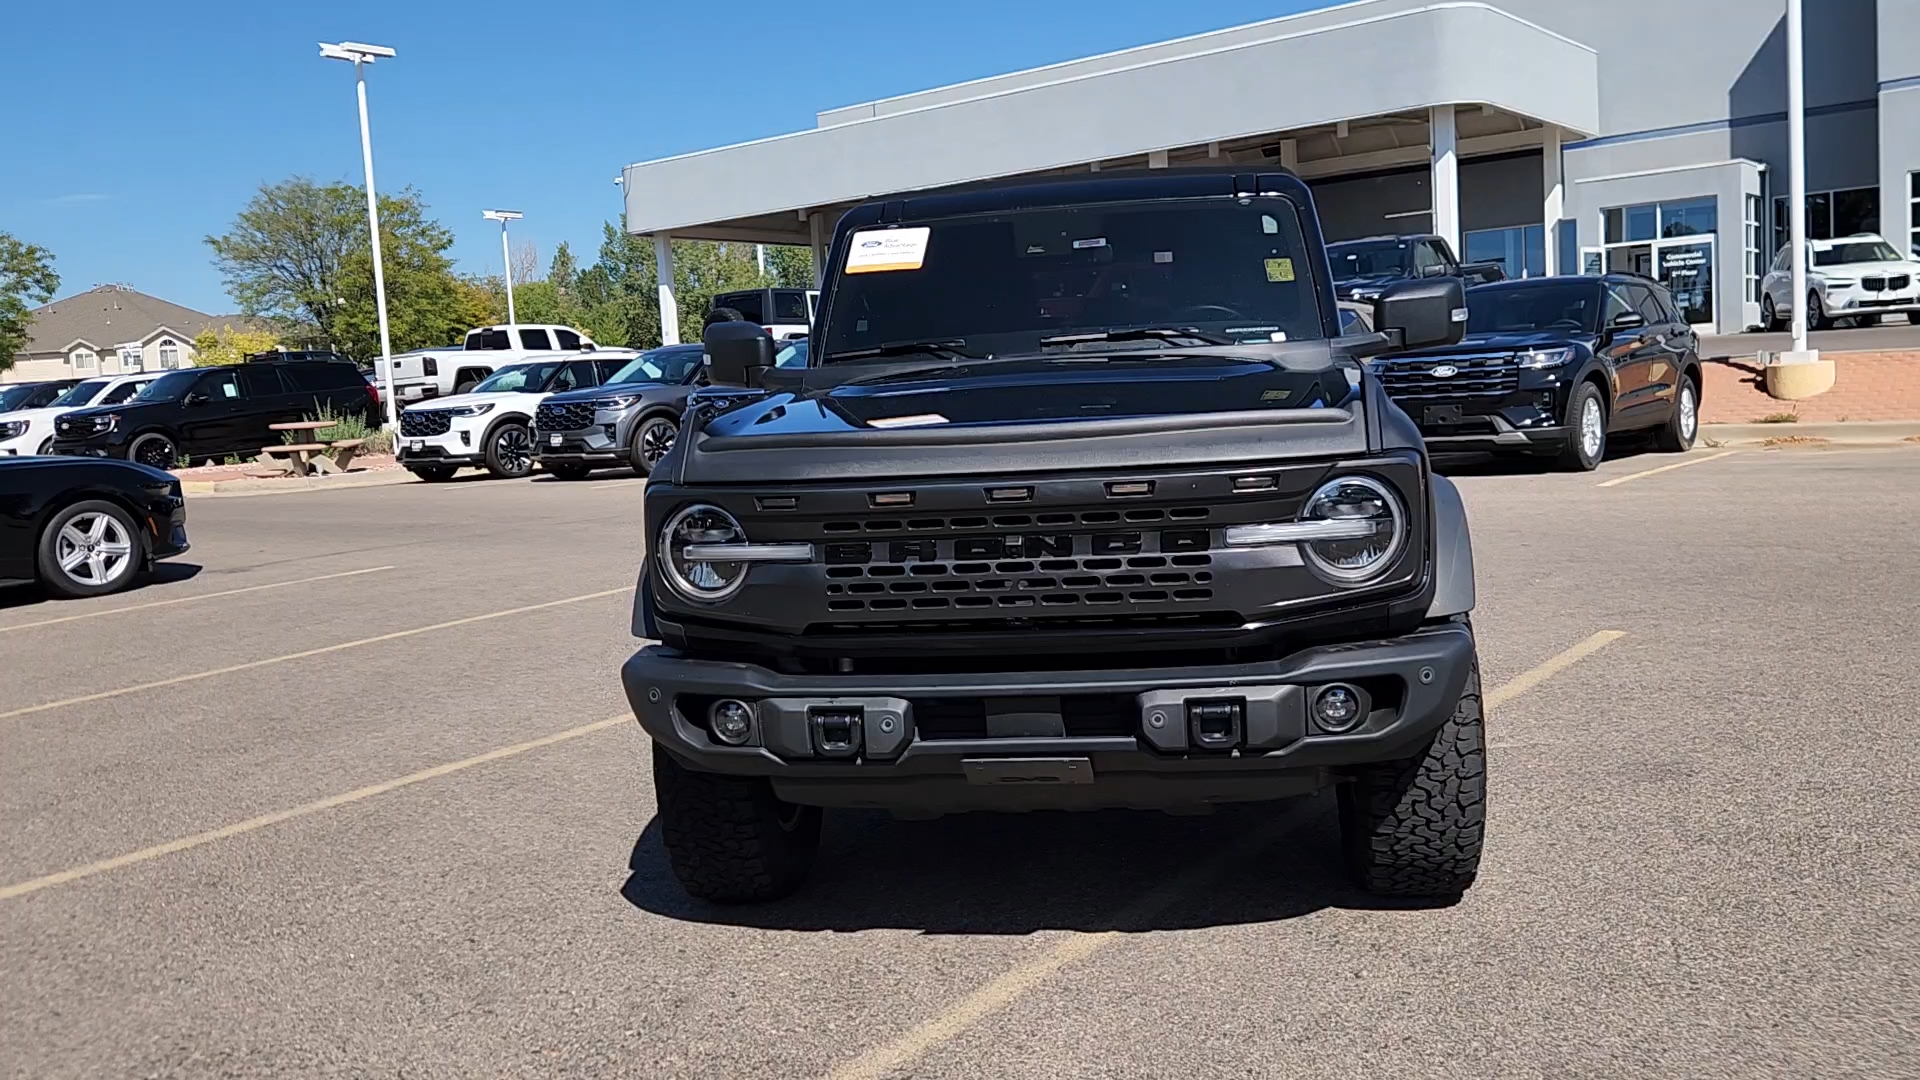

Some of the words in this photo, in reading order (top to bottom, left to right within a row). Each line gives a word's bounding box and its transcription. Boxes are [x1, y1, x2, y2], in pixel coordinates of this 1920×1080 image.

[1666, 250, 1703, 260] Commercial
[1662, 260, 1685, 268] Vehicle
[1685, 257, 1707, 266] Center
[825, 529, 1211, 564] BRONCO
